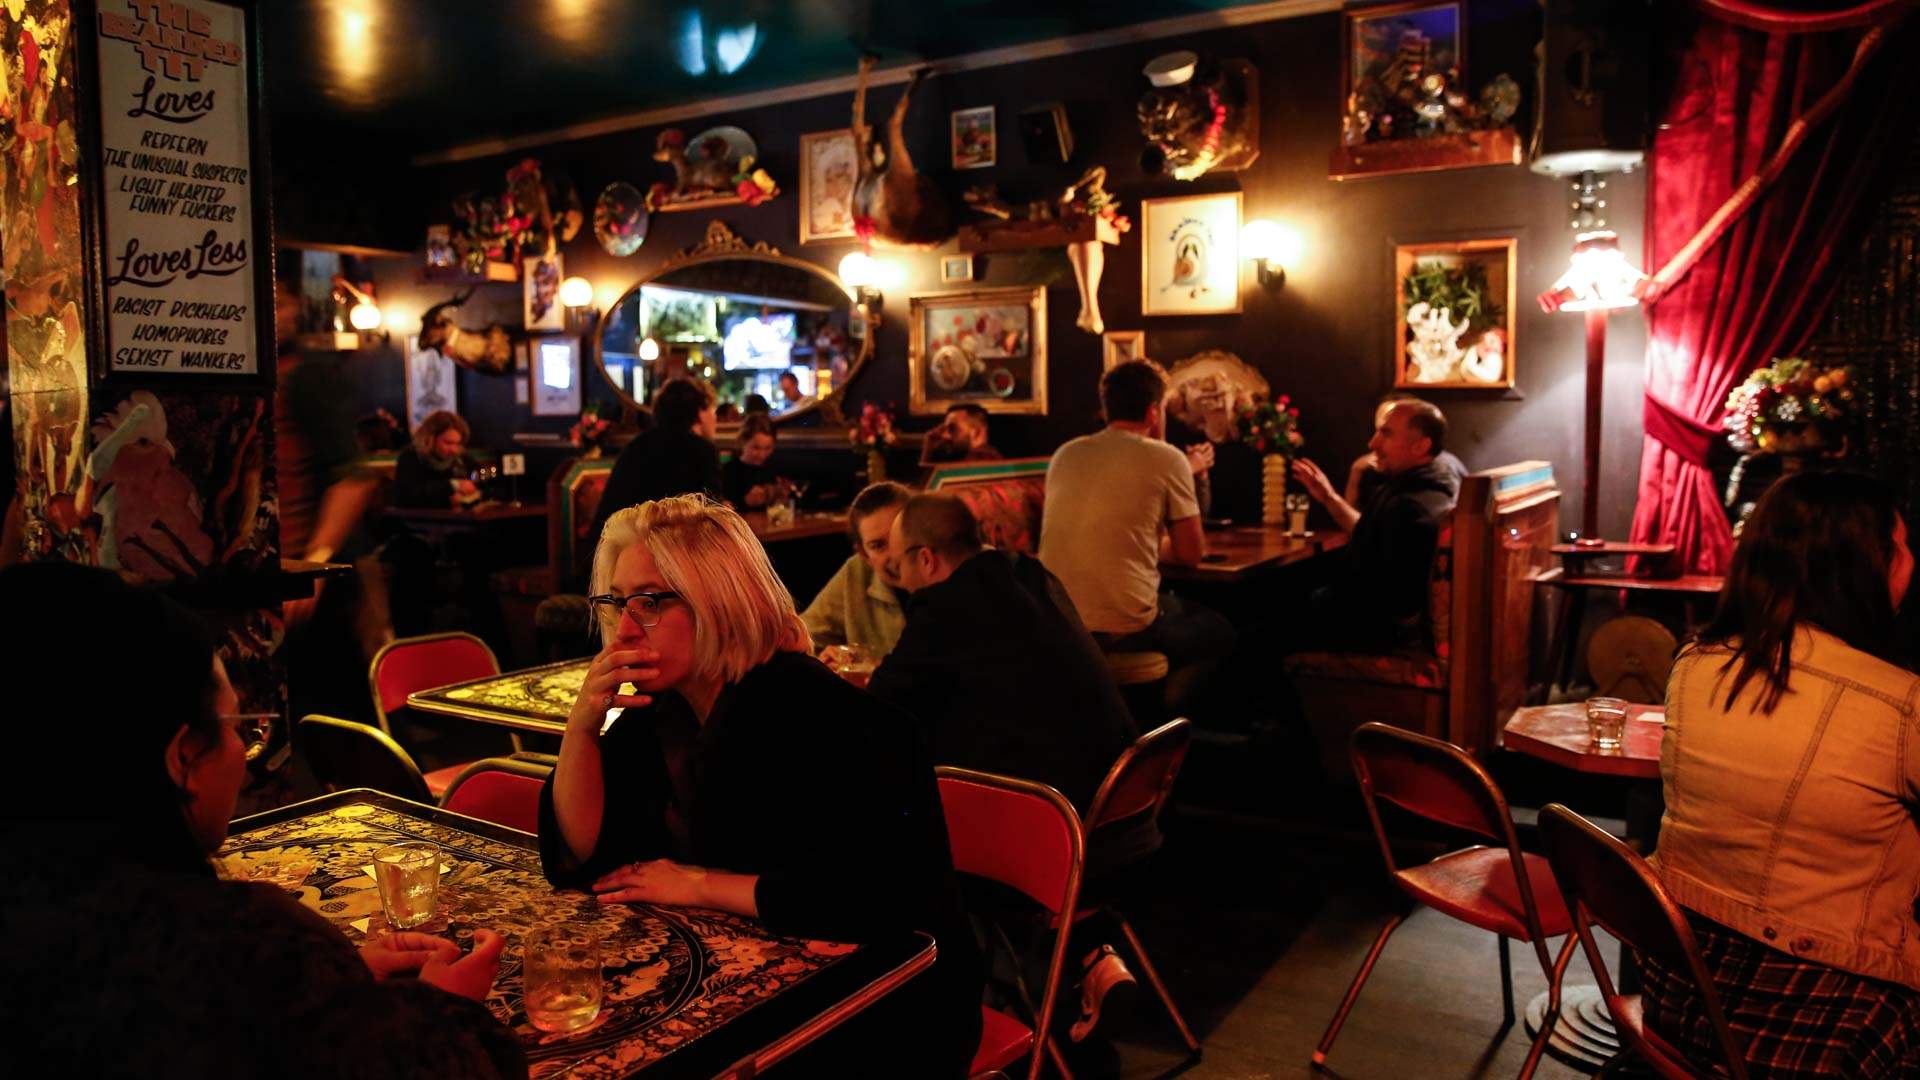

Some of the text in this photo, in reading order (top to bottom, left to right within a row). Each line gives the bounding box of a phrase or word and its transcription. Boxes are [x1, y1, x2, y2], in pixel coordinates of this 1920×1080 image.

[127, 75, 216, 124] Loves
[140, 130, 208, 156] REDFERN
[104, 147, 248, 186] THE UNUSUAL SUSPECTS
[119, 175, 226, 203] LIGHT HEARTED
[129, 194, 237, 224] FUNNY FUCKERS
[107, 229, 248, 288] Loves Less
[112, 297, 247, 322] RACIST DICKHEADS
[131, 323, 229, 345] HOMOPHOBES
[115, 348, 246, 370] SEXIST WANKERS
